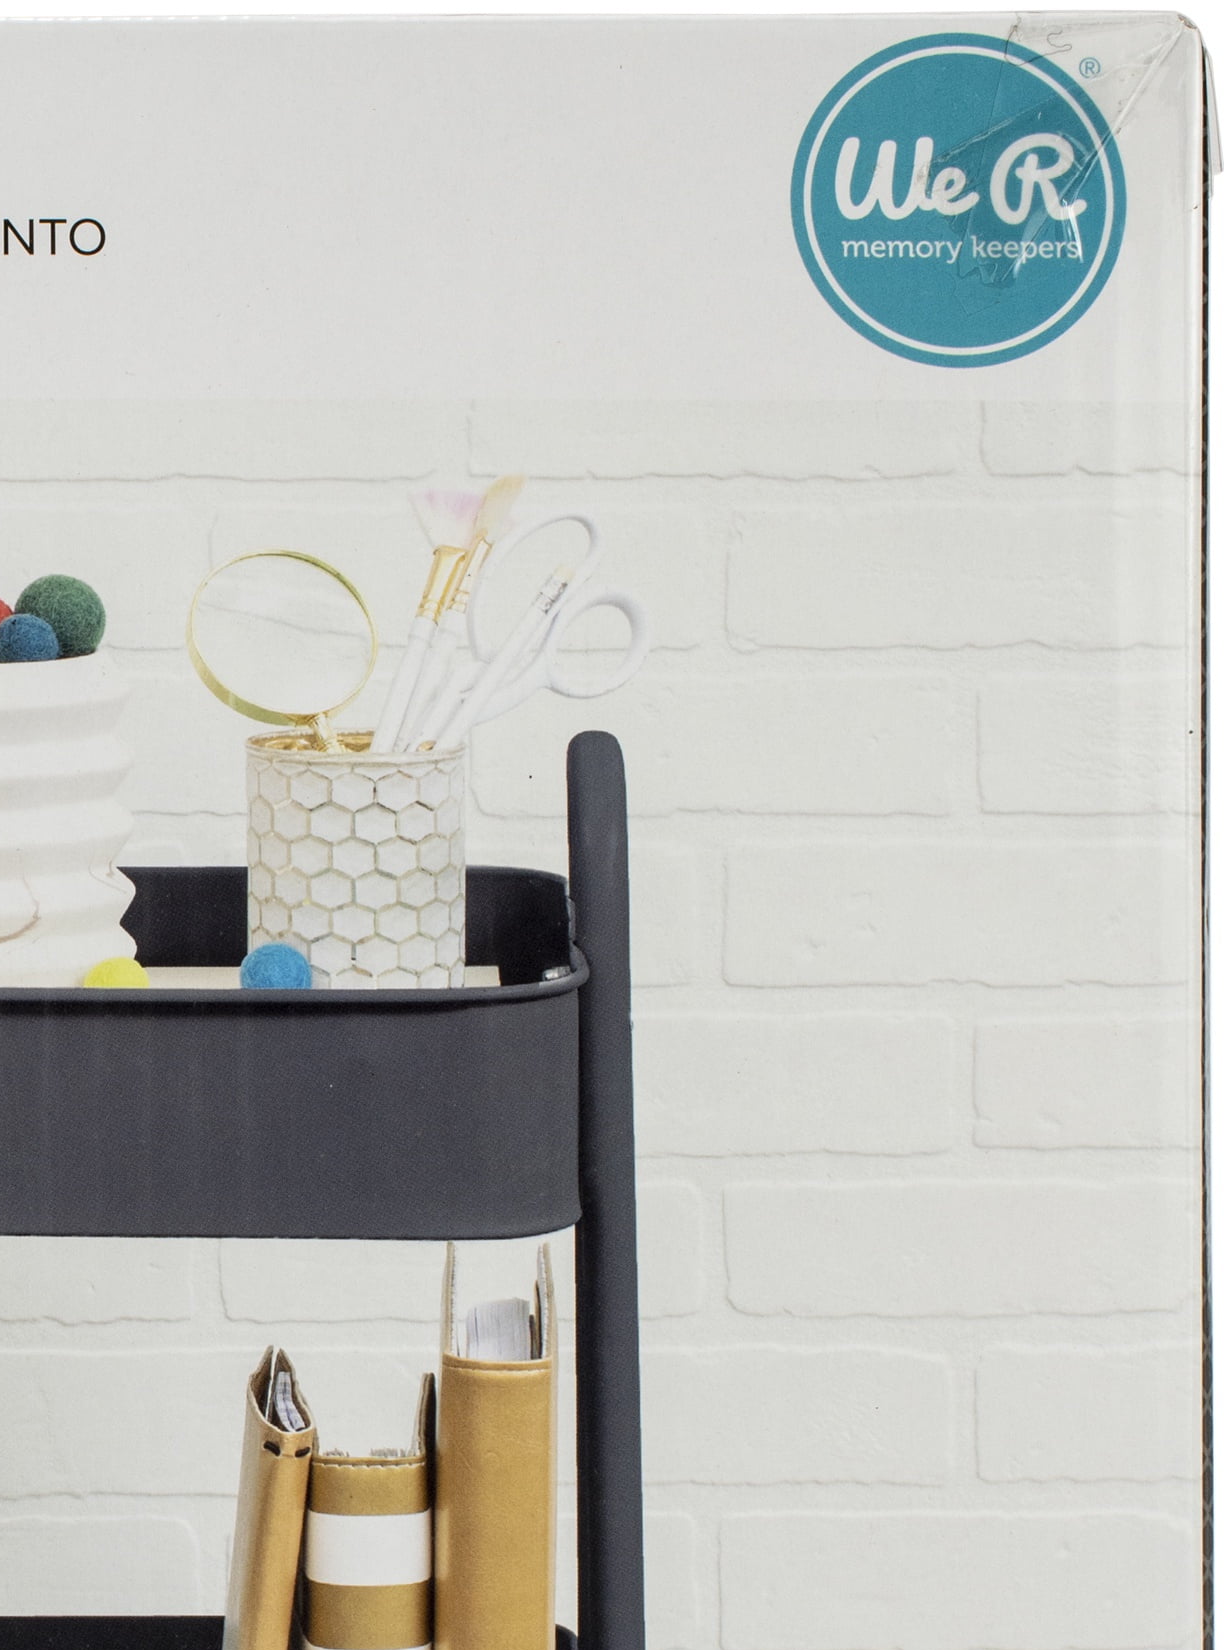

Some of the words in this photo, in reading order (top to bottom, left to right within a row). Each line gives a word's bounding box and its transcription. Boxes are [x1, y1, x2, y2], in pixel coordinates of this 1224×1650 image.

[834, 136, 980, 221] We
[989, 131, 1087, 225] R
[841, 238, 963, 264] memory
[971, 234, 1081, 265] keepers
